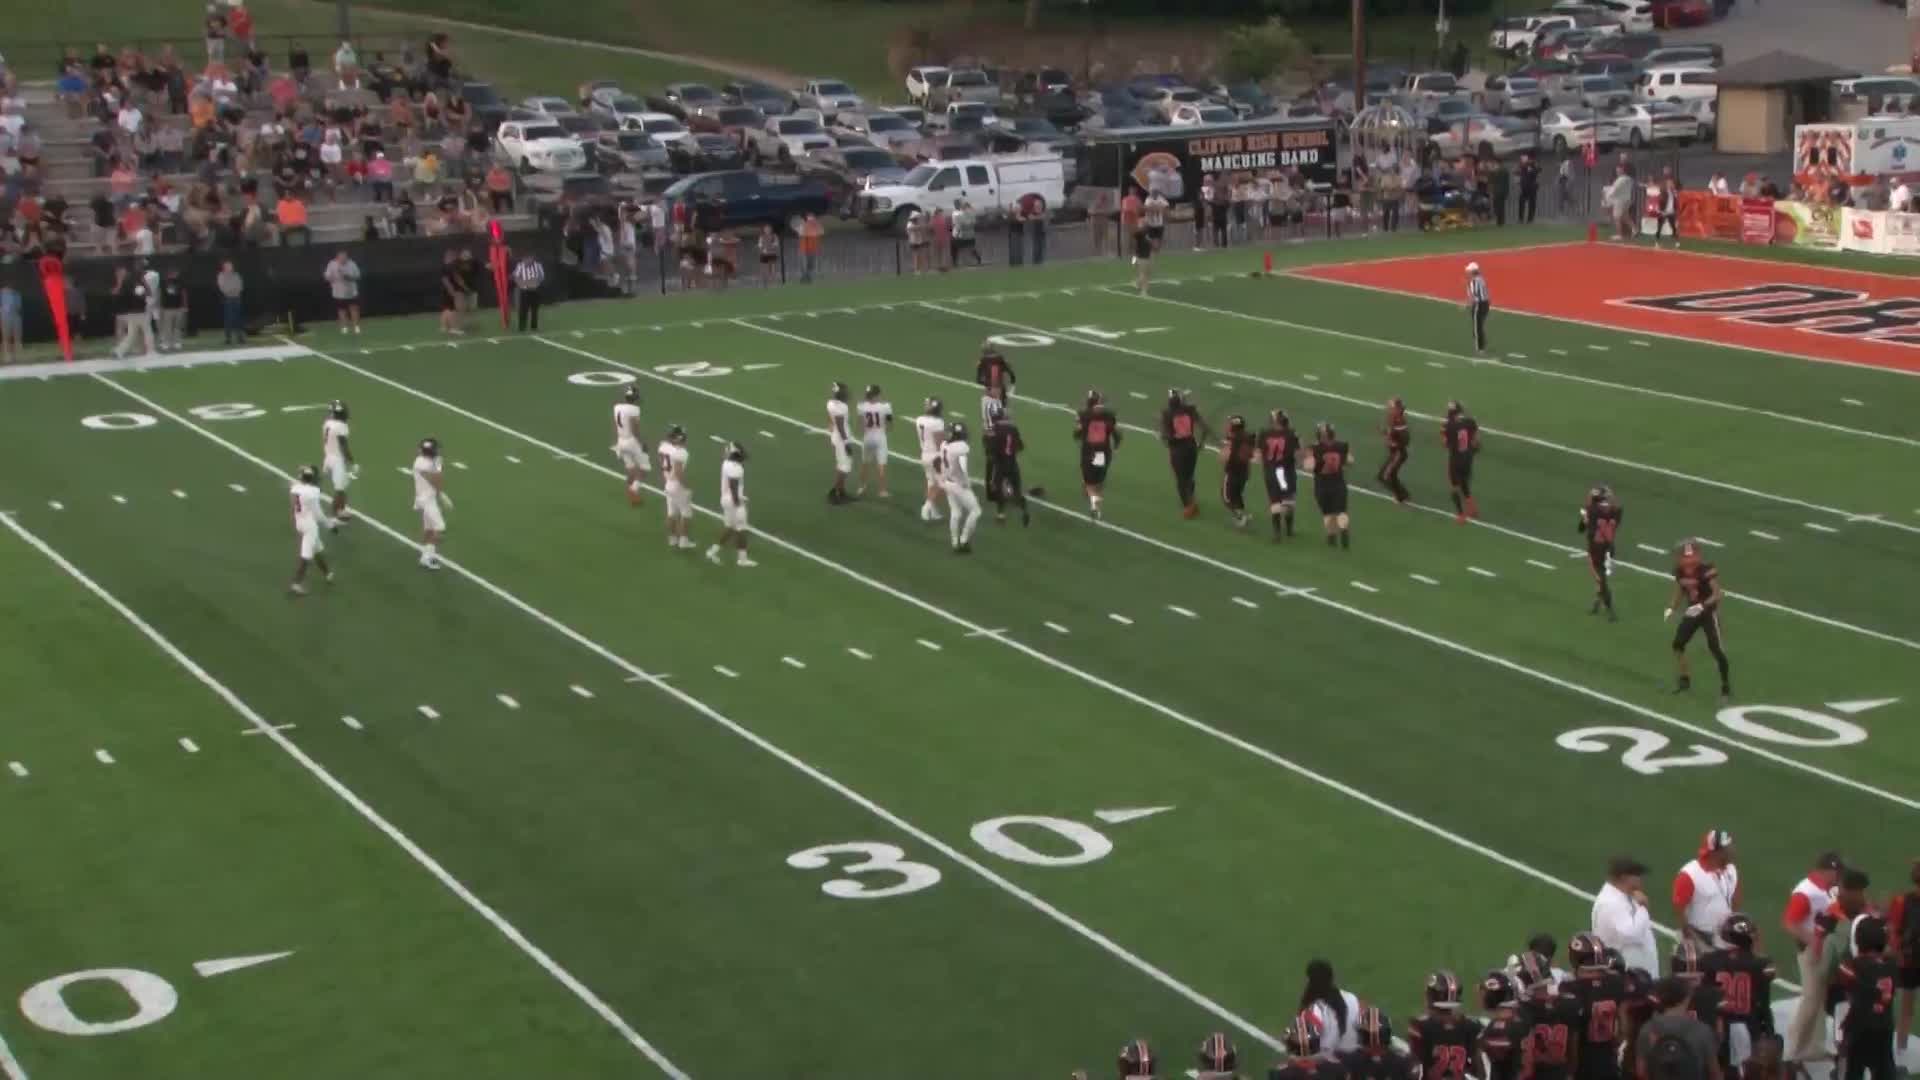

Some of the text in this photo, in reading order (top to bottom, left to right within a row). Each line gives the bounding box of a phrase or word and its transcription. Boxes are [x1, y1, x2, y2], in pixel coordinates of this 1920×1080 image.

[1201, 149, 1319, 171] MARCHING BAND
[786, 814, 1113, 899] 30
